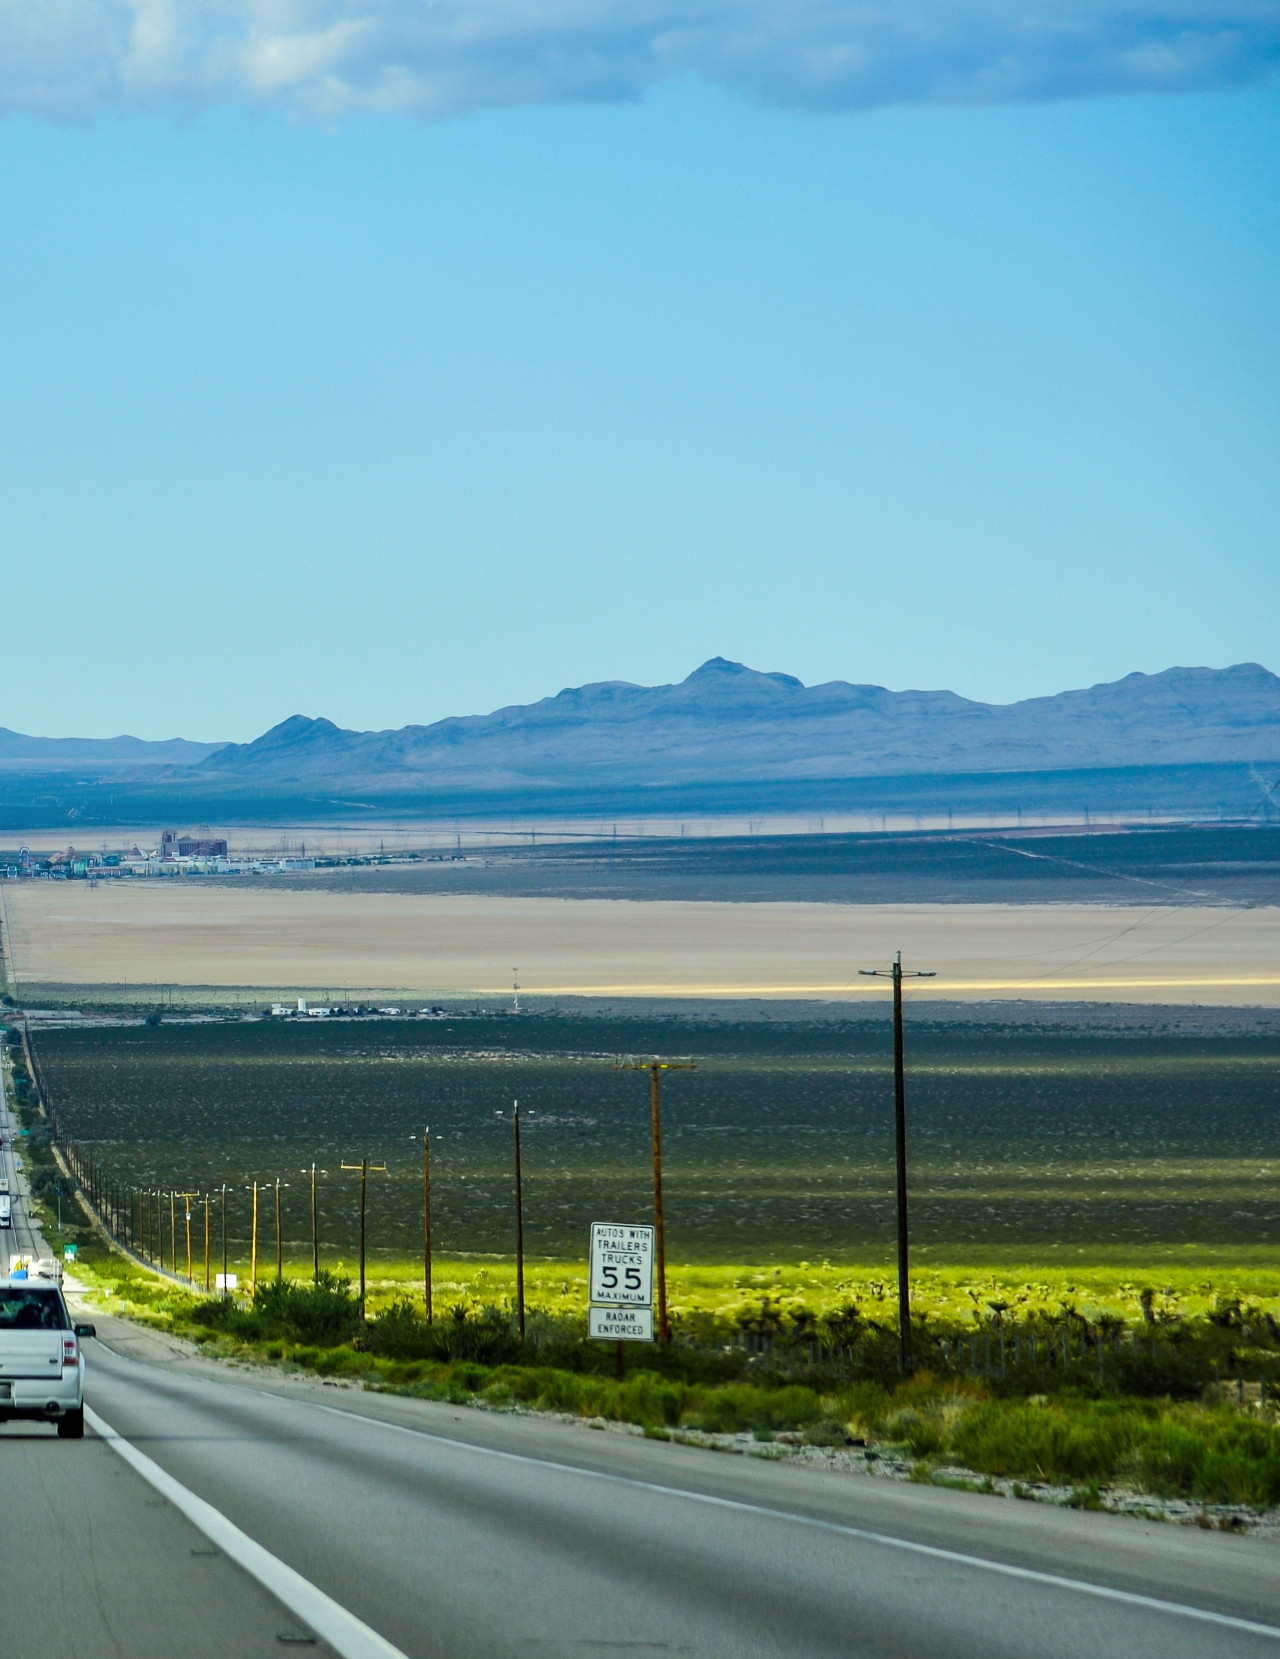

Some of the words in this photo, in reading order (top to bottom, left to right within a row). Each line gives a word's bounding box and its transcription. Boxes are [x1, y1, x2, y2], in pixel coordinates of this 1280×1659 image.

[596, 1228, 624, 1238] AUTOS
[629, 1230, 650, 1239] WITH
[597, 1240, 648, 1252] TRAILERS
[602, 1253, 642, 1265] TRUCKS
[601, 1266, 642, 1290] 55
[597, 1291, 645, 1301] MAXIMUM
[606, 1312, 635, 1322] RADAR
[598, 1324, 643, 1335] ENFORCED
